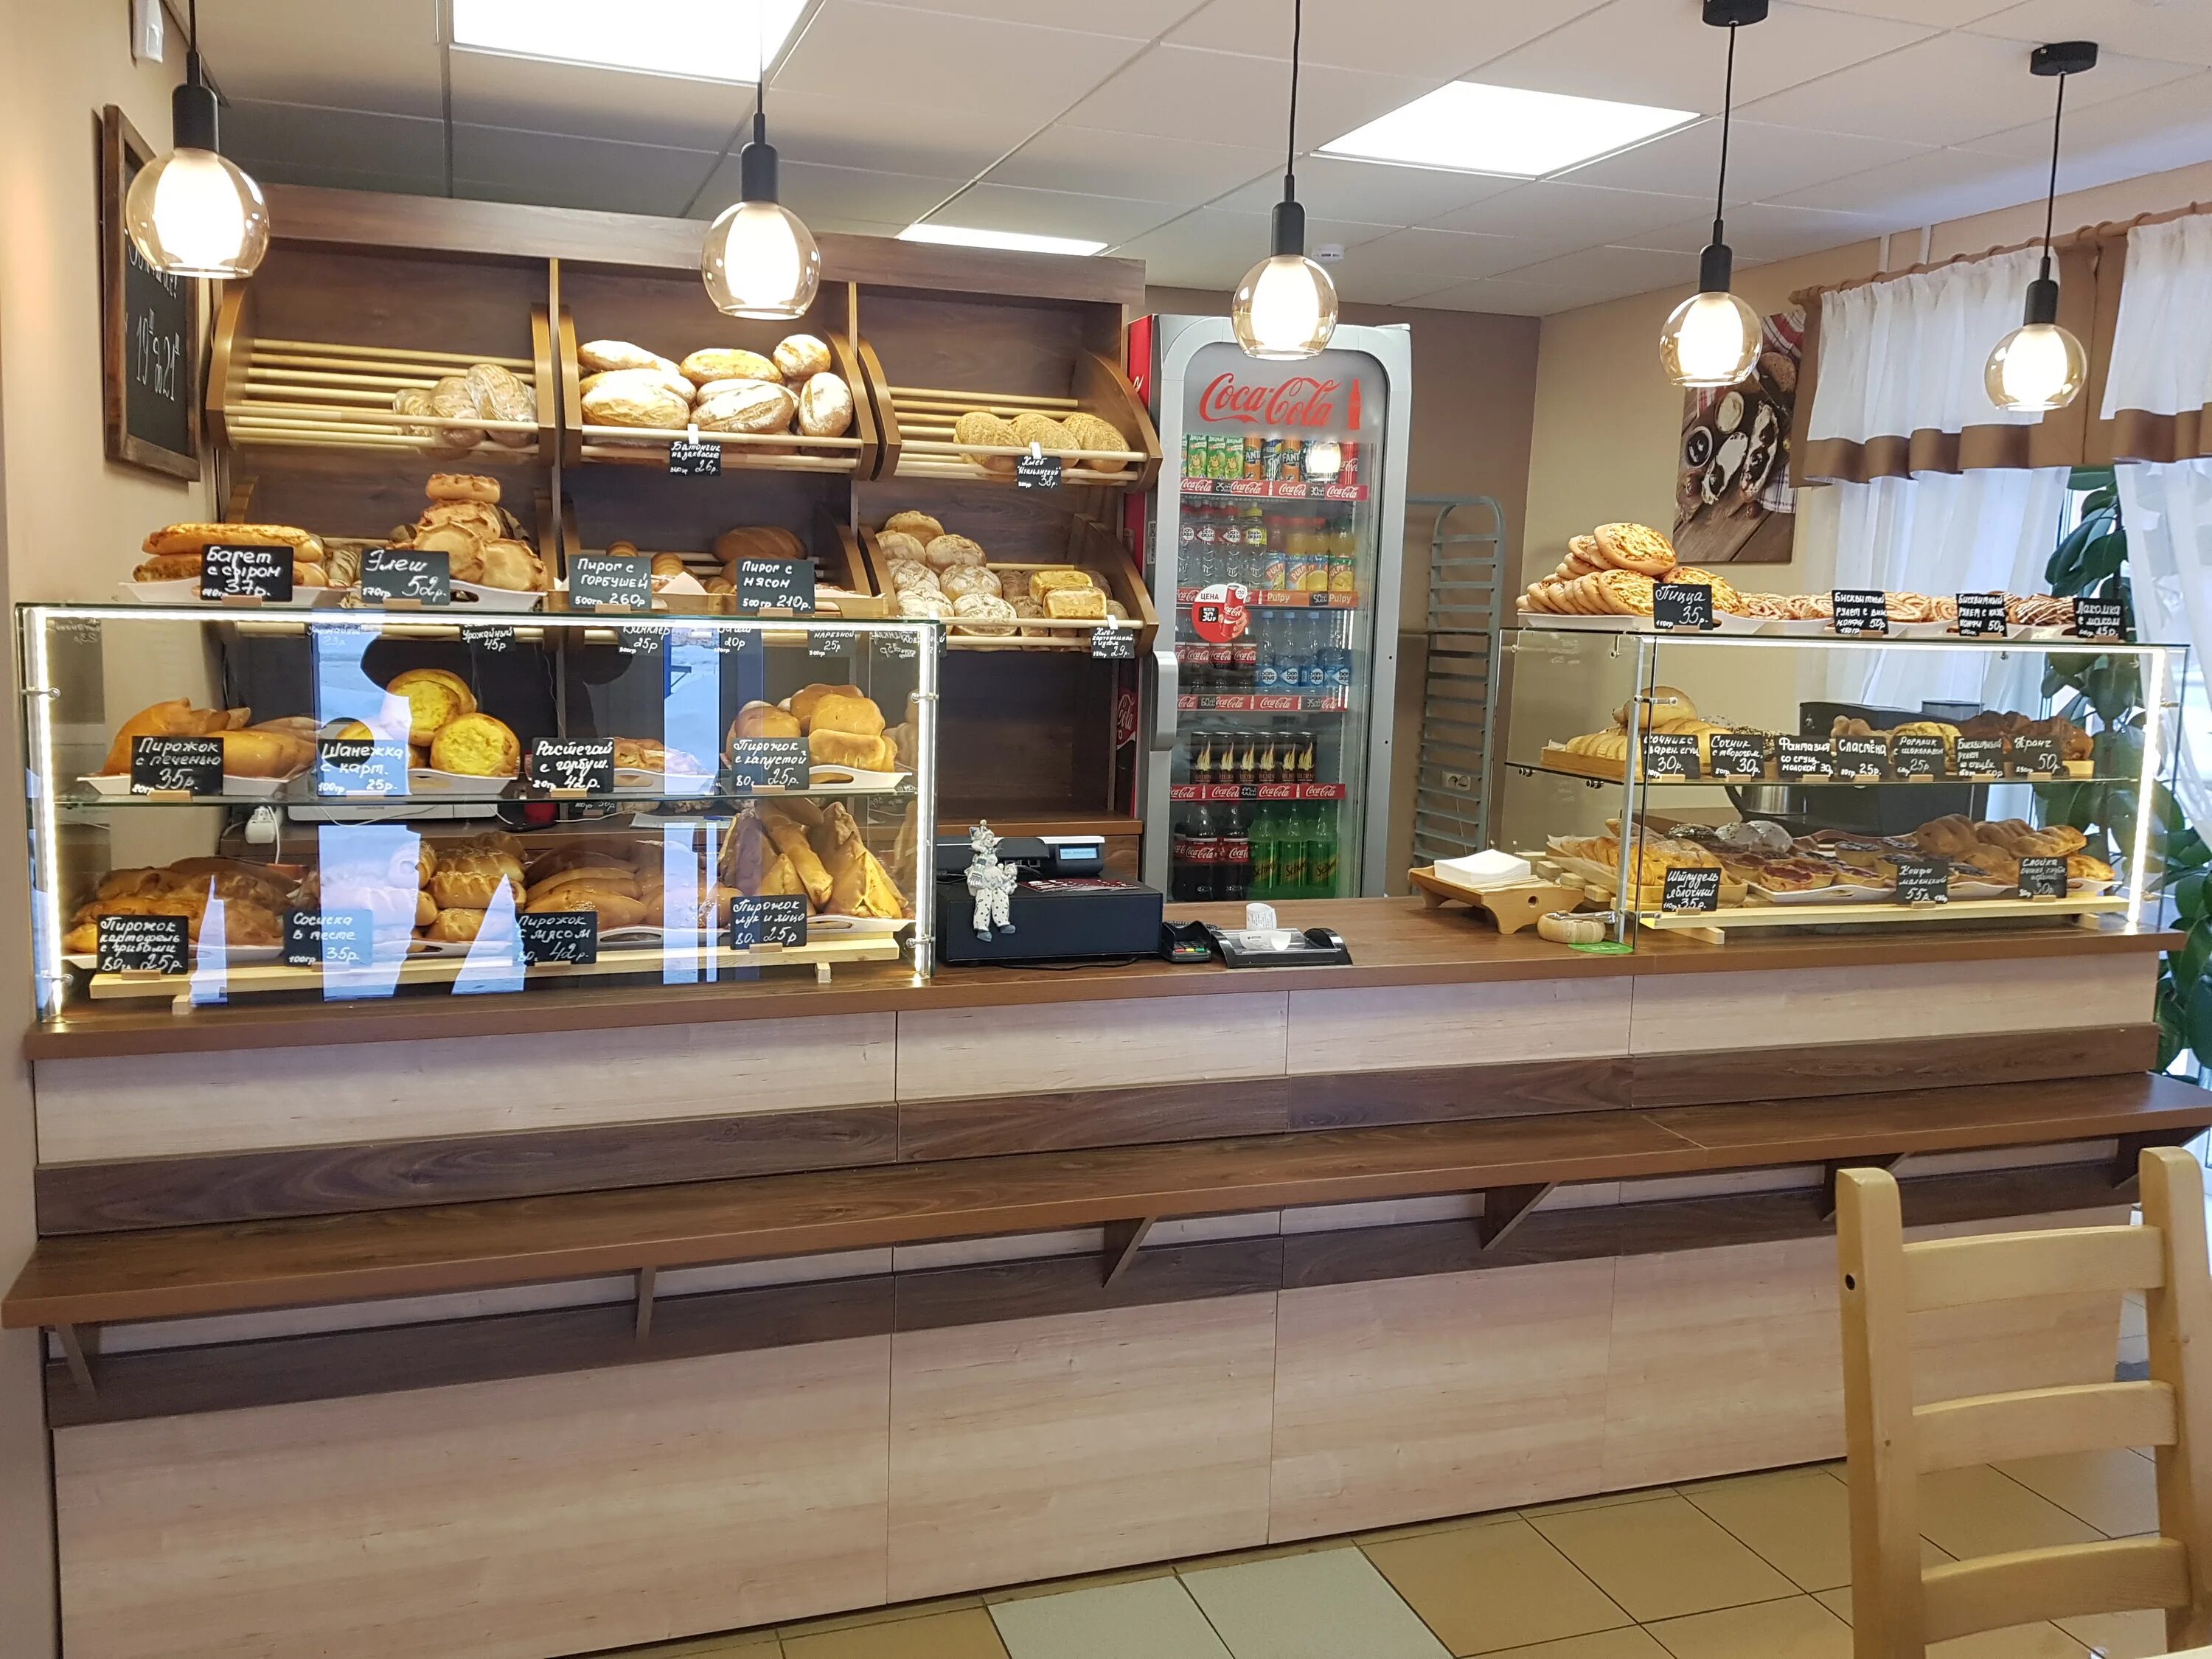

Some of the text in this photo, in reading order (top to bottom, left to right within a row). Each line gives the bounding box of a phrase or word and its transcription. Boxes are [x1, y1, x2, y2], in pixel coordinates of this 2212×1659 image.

[1199, 373, 1342, 427] Coca-Cola
[206, 546, 271, 564] Багет
[221, 566, 281, 581] сыром
[577, 558, 622, 574] Пирог
[1267, 563, 1284, 579] PULPY
[1200, 593, 1220, 601] ЦЕНА
[1267, 593, 1290, 604] Pulpy
[1329, 594, 1352, 605] Pulpy
[1655, 585, 1706, 603] Пицца
[1678, 605, 1709, 626] 35р.
[484, 638, 507, 652] 45р
[1260, 696, 1290, 709] Coca-Cola
[139, 737, 218, 757] Пирожок
[536, 740, 613, 756] Растегай
[733, 740, 799, 757] Пирожок
[1711, 736, 1751, 748] Сочник
[1778, 737, 1830, 752] Фантазия
[1839, 739, 1887, 757] Сластёна
[321, 742, 404, 760] Шанежка
[150, 754, 221, 766] печенью
[556, 758, 609, 777] горбуш.
[745, 751, 807, 770] капустой
[339, 762, 389, 779] карт.
[1259, 785, 1290, 798] Coca-Cola
[1306, 785, 1336, 797] Coca-Cola
[1667, 870, 1719, 889] Штрудель
[1666, 884, 1716, 899] яблочный
[733, 899, 800, 915] Пирожок
[100, 917, 176, 935] Пирожок
[293, 912, 353, 925] Сосиска
[518, 915, 587, 928] Пирожок
[735, 915, 760, 929] лук
[773, 910, 805, 923] яйцо
[100, 933, 180, 944] картофель
[310, 931, 358, 941] тесте
[531, 928, 591, 943] мясом
